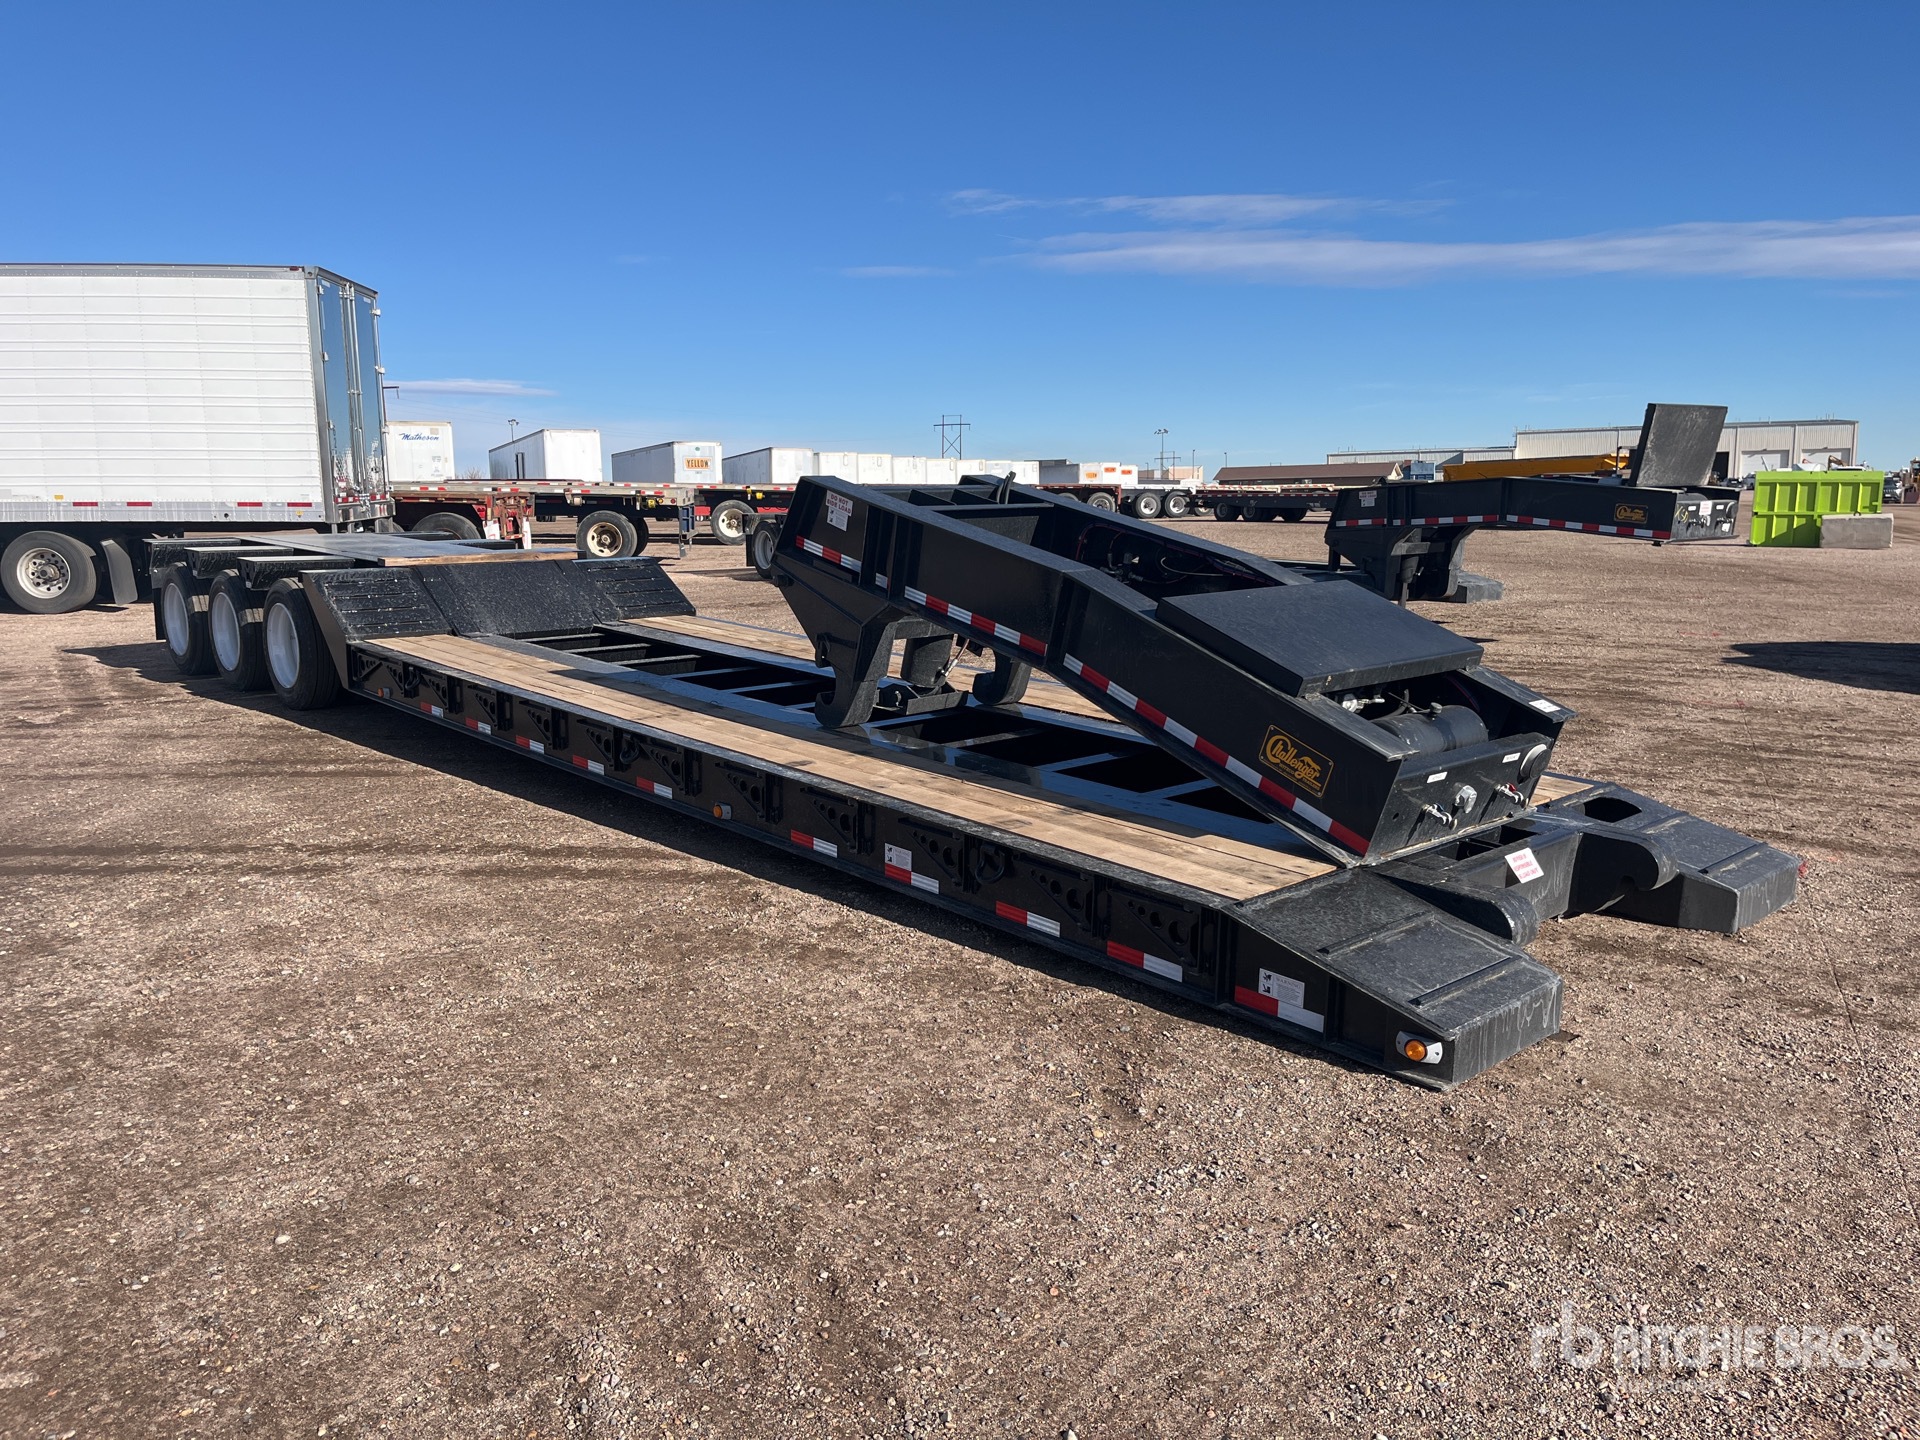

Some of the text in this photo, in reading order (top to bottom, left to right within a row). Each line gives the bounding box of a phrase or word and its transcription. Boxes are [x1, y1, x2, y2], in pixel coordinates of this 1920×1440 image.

[839, 497, 848, 506] NOT
[838, 503, 851, 514] LOAD
[1266, 735, 1322, 787] Challenger
